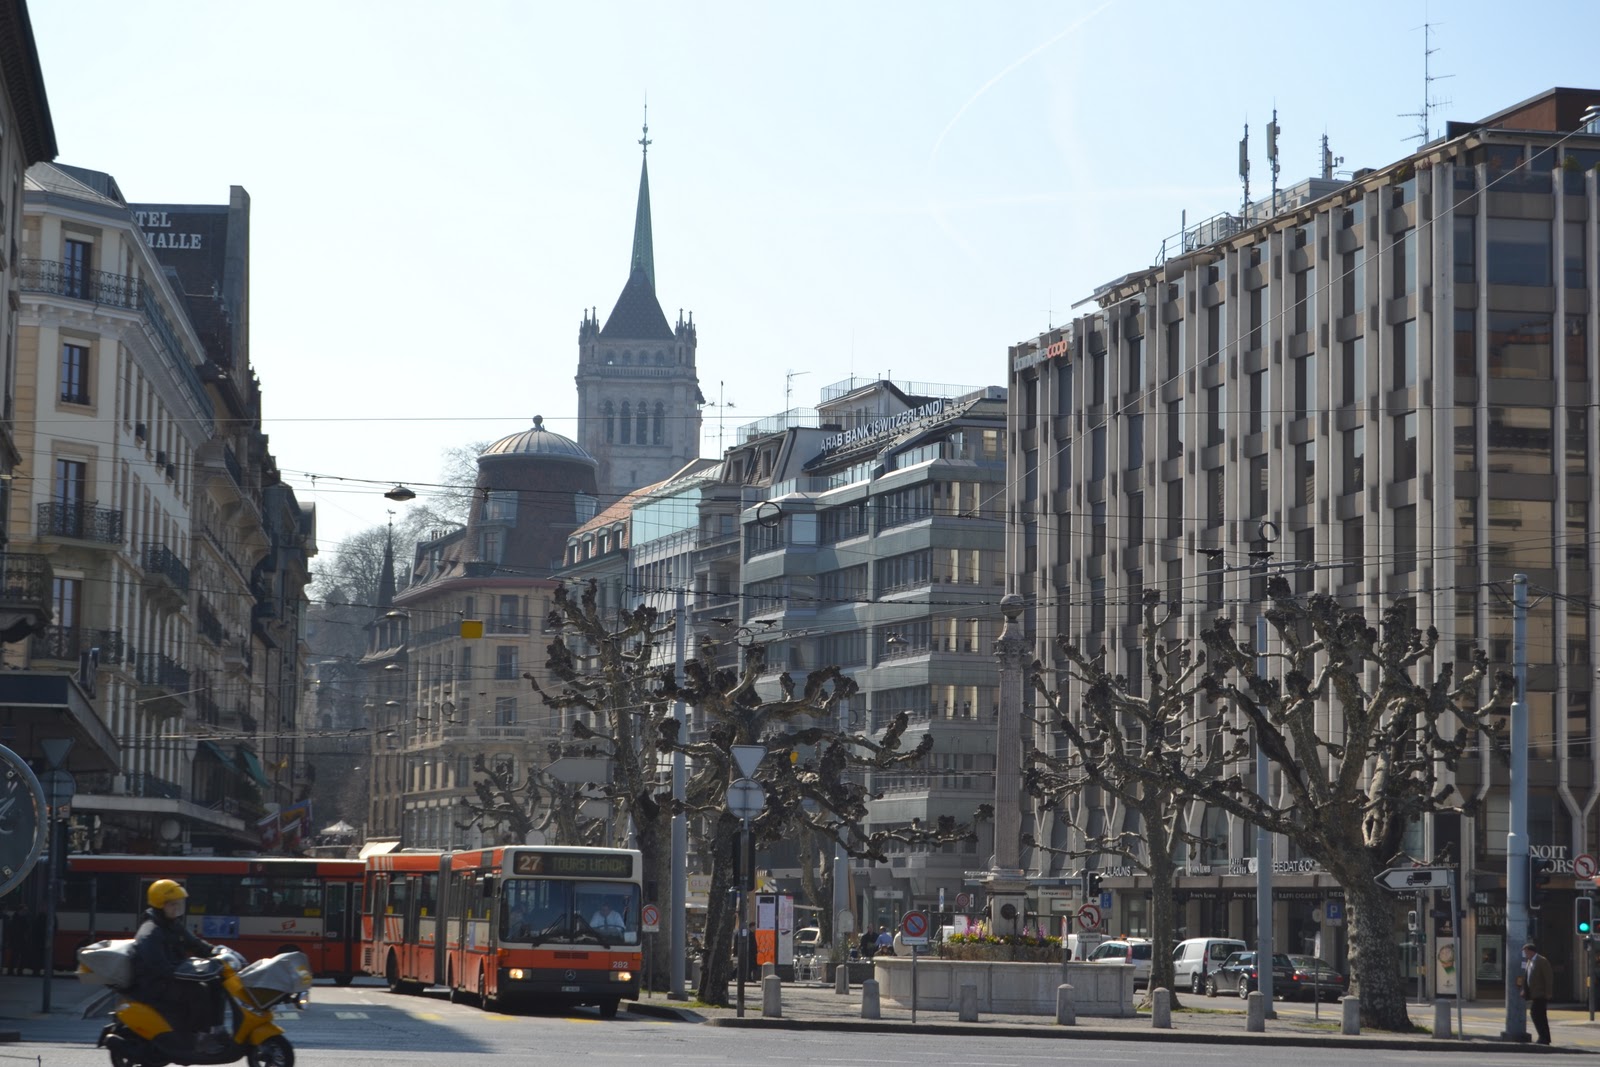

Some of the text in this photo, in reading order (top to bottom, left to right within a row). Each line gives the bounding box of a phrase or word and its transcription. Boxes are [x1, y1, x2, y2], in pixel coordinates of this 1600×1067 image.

[1046, 339, 1068, 358] coop
[820, 398, 943, 452] ARAB BANK (SWITZERLAND)
[519, 855, 542, 871] 27
[552, 857, 587, 872] TOURS
[1541, 859, 1575, 873] ORS
[612, 961, 629, 969] 282
